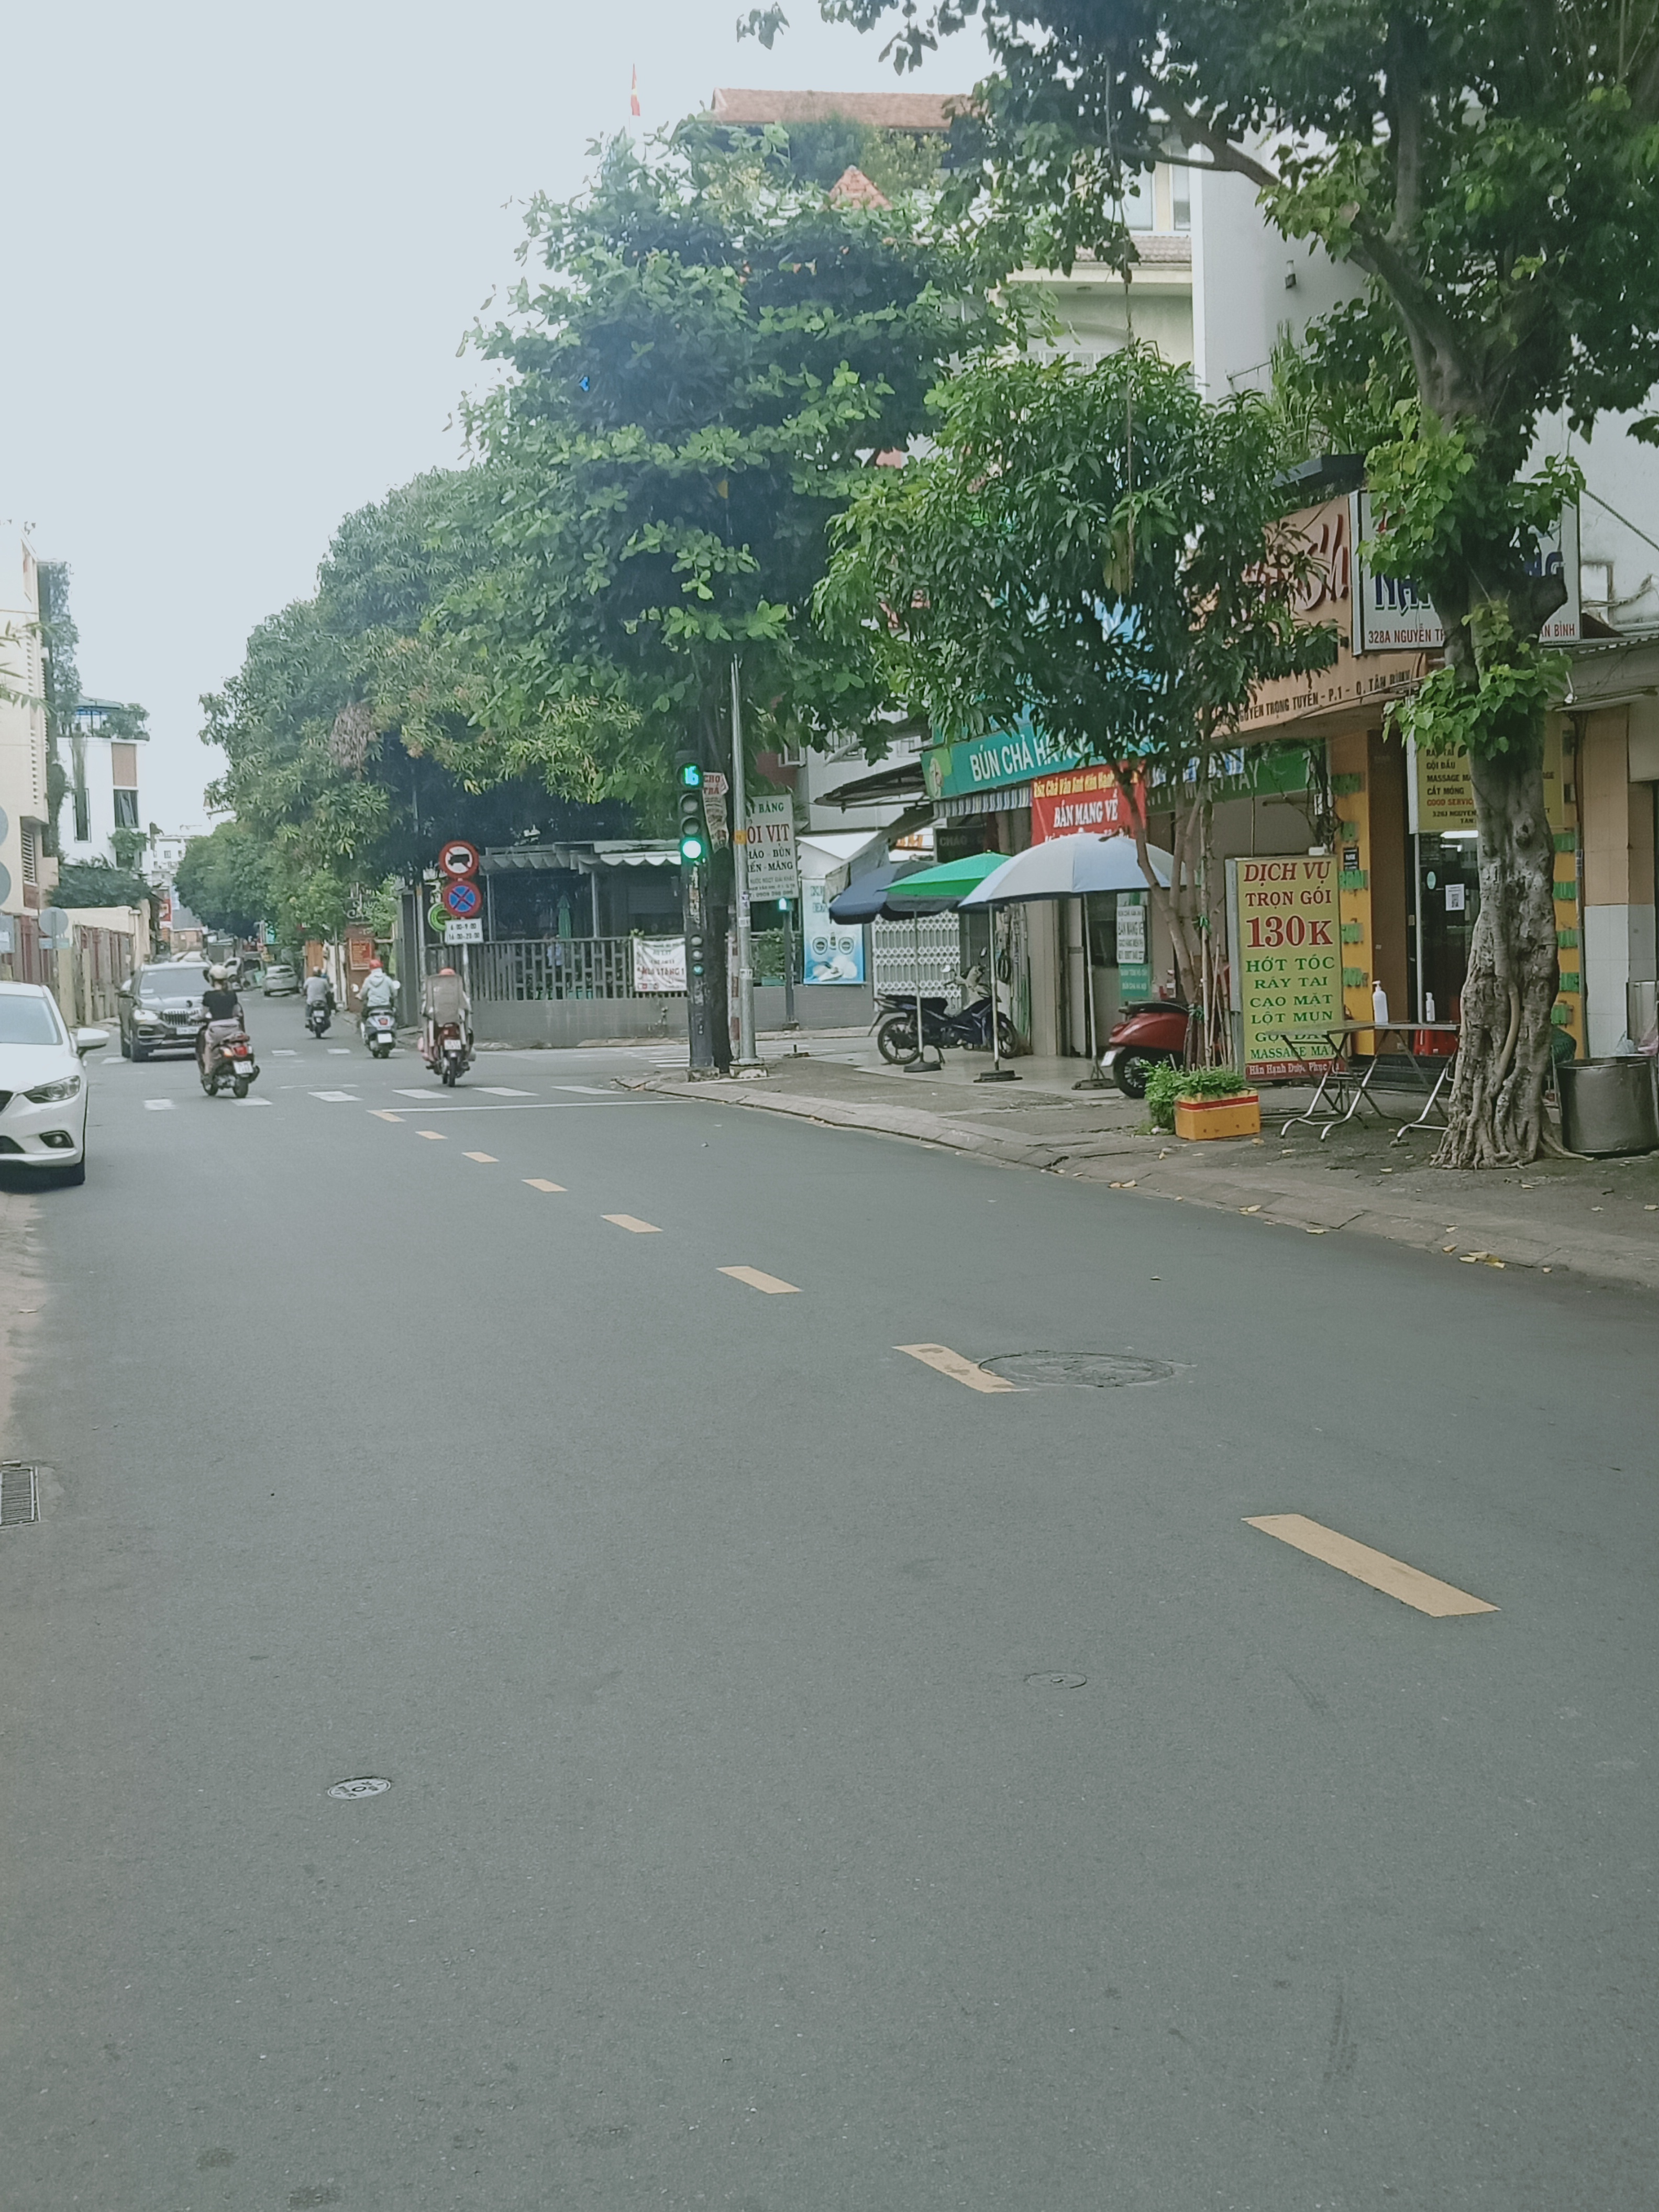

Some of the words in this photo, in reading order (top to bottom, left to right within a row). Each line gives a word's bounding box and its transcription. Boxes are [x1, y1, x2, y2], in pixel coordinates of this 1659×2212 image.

[1368, 630, 1391, 644] 328A
[1394, 623, 1432, 644] NGUYỄN
[1554, 621, 1576, 637] BÌNH
[1266, 698, 1289, 720] TRỌNG
[970, 744, 1001, 782] BÚN
[1001, 734, 1035, 775] CHẢ
[684, 765, 699, 786] 16
[1426, 774, 1460, 782] MASSAGE
[1447, 798, 1474, 806] SERVIC
[1054, 799, 1074, 828] BÁN
[1075, 801, 1103, 826] MANG
[747, 819, 762, 844] ỎI
[766, 823, 790, 846] VỊT
[1243, 862, 1298, 887] DỊCH
[1303, 861, 1332, 884] VỤ
[1244, 891, 1294, 910] TRỌN
[1300, 886, 1332, 905] GÓI
[1245, 915, 1334, 948] 130K
[1246, 956, 1288, 973] HỚT
[1295, 953, 1335, 970] TÓC
[1254, 976, 1291, 989] RÁY
[1298, 976, 1328, 987] TAI
[1249, 996, 1287, 1010] CẠO
[1293, 992, 1334, 1007] MẶT
[1251, 1011, 1286, 1026] LỘT
[1293, 1010, 1333, 1024] MỤN
